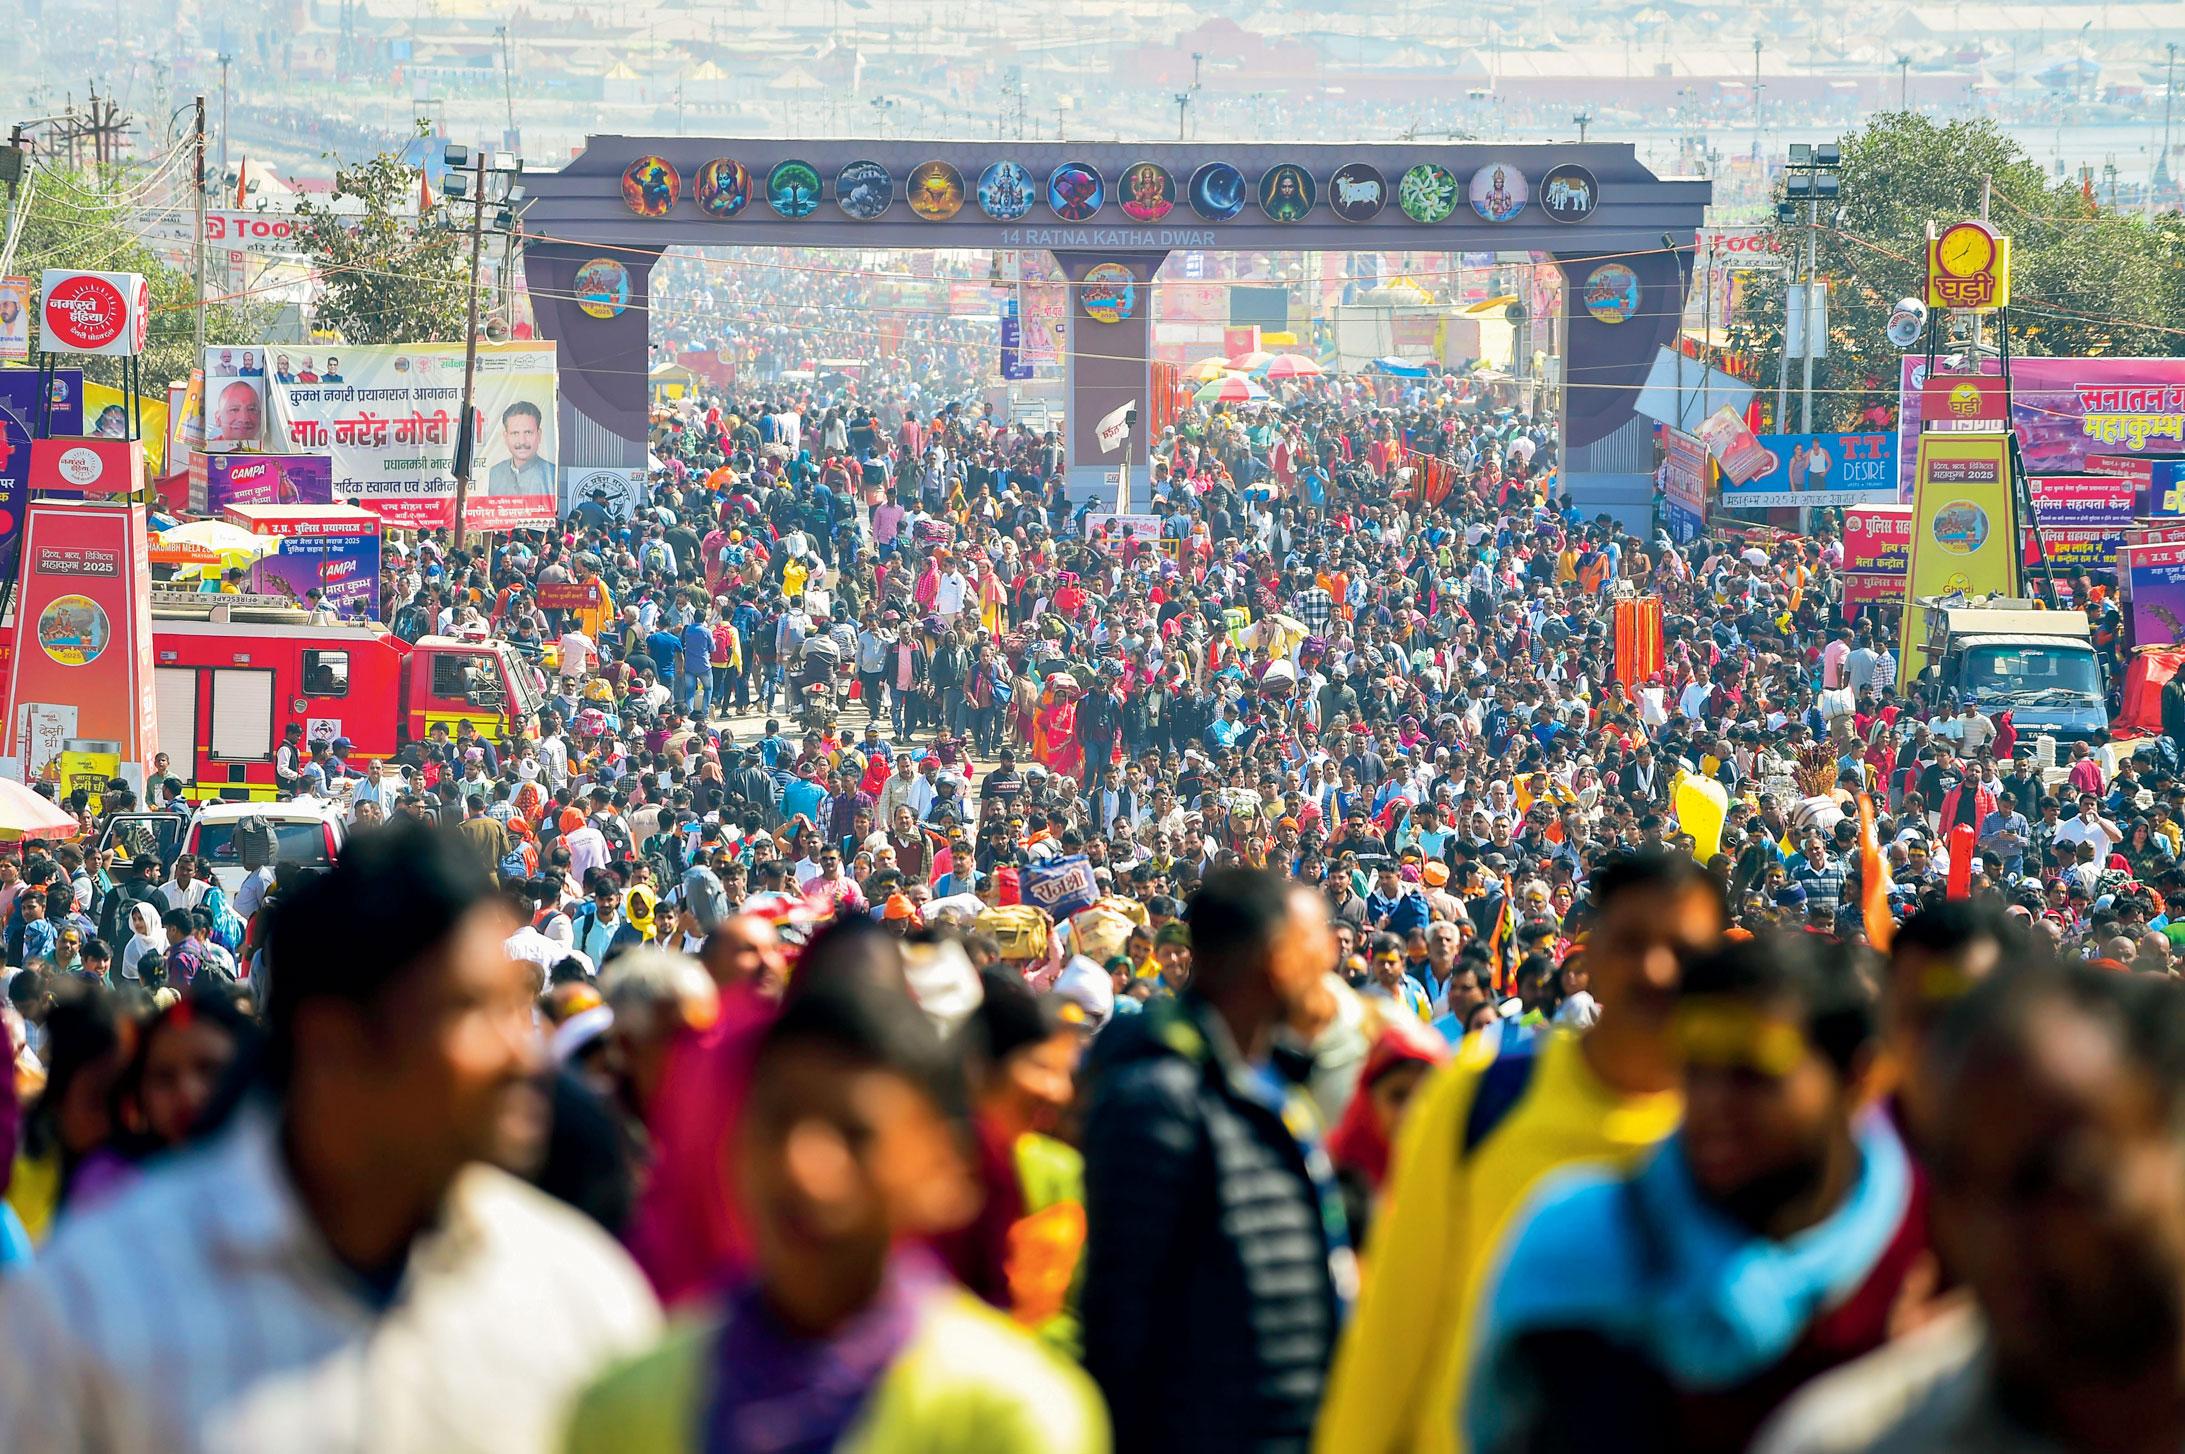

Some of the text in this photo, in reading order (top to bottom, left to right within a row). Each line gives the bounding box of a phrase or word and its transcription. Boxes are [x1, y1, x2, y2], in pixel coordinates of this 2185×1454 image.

[1001, 230, 1216, 246] 14 RATNA KATHA DWAR
[290, 390, 320, 406] कुम्भ
[324, 386, 354, 402] नगरी
[357, 389, 409, 402] प्रयागराज
[413, 387, 458, 400] आगमन
[2074, 385, 2165, 411] सनातन
[333, 410, 389, 448] नरेंद्र
[393, 409, 449, 445] मोदी
[2083, 413, 2183, 450] महाकुम्भ
[383, 456, 427, 471] प्रधानमंत्री
[1844, 461, 1886, 481] DESIRE
[231, 463, 266, 481] CAMPA
[1968, 471, 1994, 479] 2025
[366, 480, 400, 493] स्वागत
[404, 478, 421, 493] एवं
[2066, 499, 2105, 511] सहायता
[2109, 495, 2131, 511] केन्द्र
[271, 522, 360, 535] उ.प्र. पुलिस प्रयागराज
[1865, 515, 1892, 538] पुलिस
[2067, 530, 2099, 542] सहायता
[84, 561, 114, 572] 2025
[212, 594, 250, 603] FIRESCAPE
